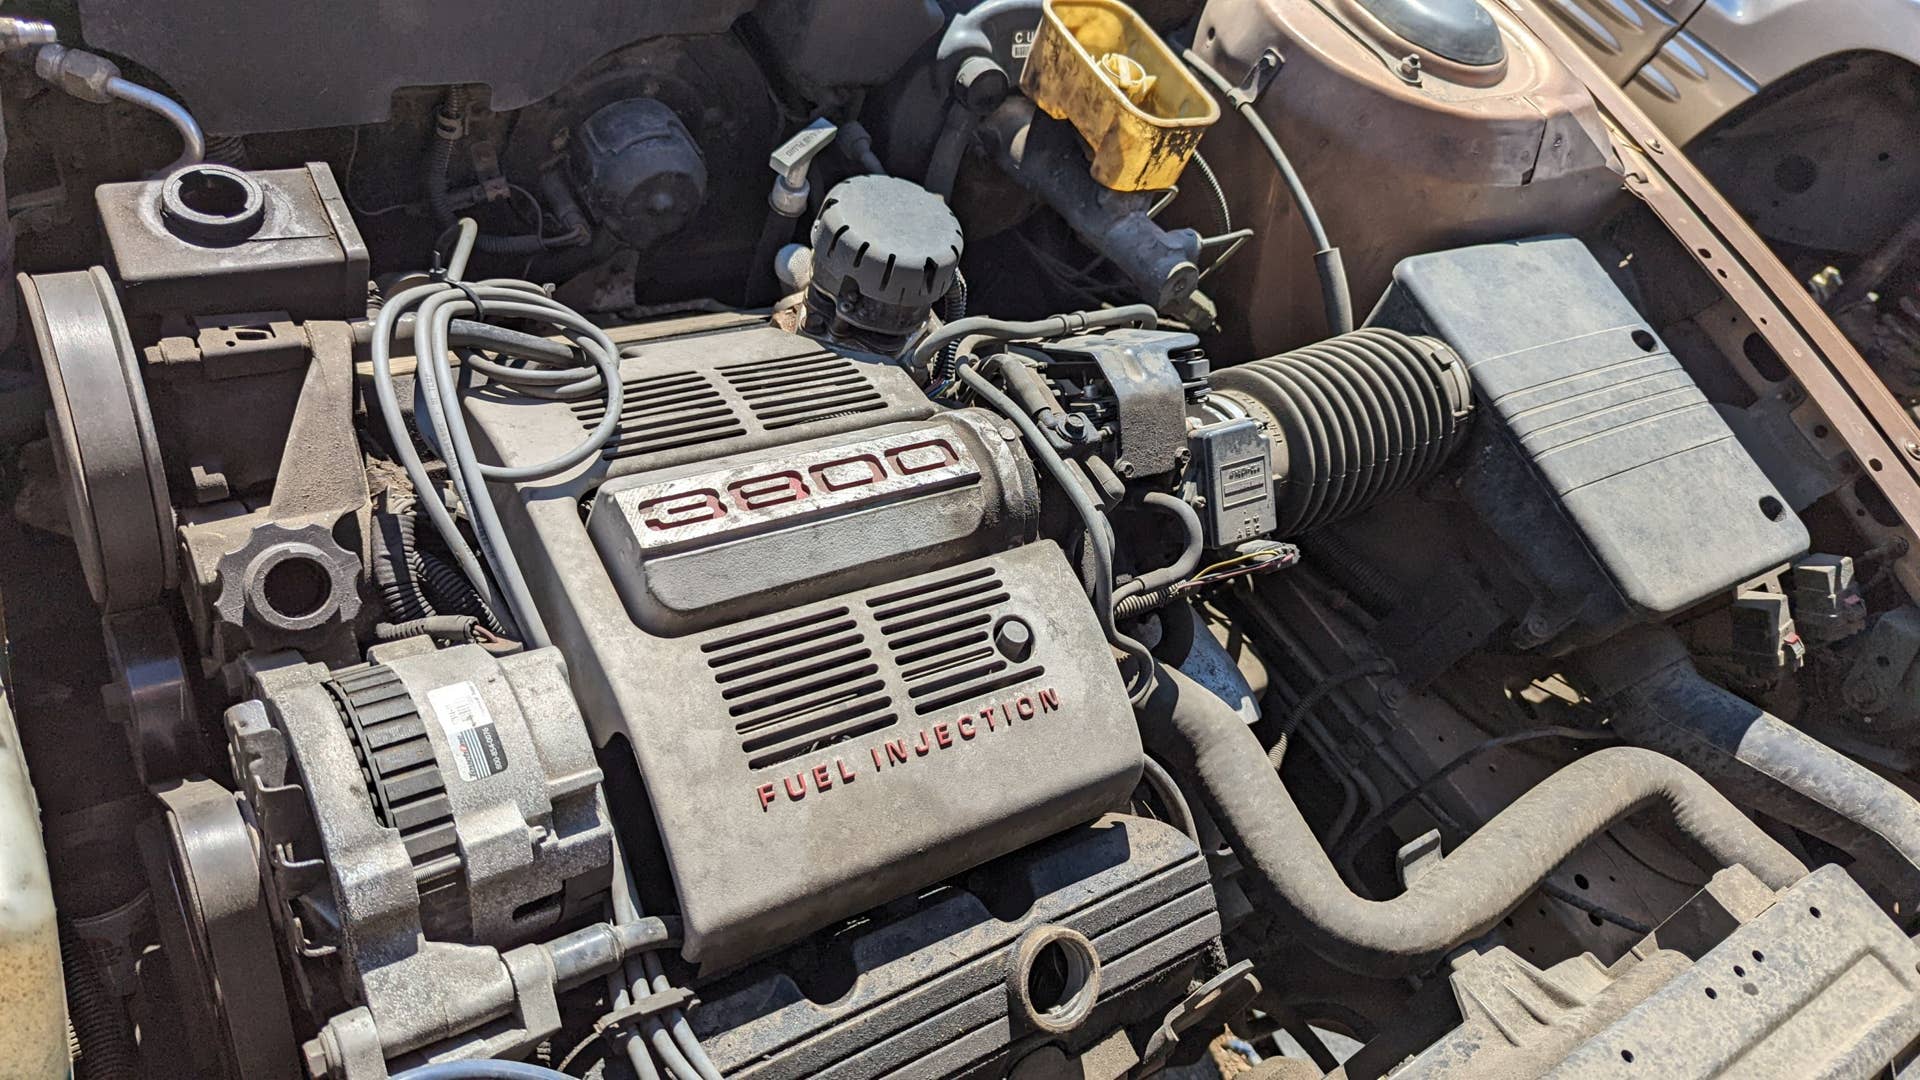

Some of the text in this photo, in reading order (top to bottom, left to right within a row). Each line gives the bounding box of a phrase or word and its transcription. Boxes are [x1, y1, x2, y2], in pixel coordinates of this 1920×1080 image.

[638, 438, 959, 531] 3800
[757, 688, 1060, 812] FUEL INJECTION
